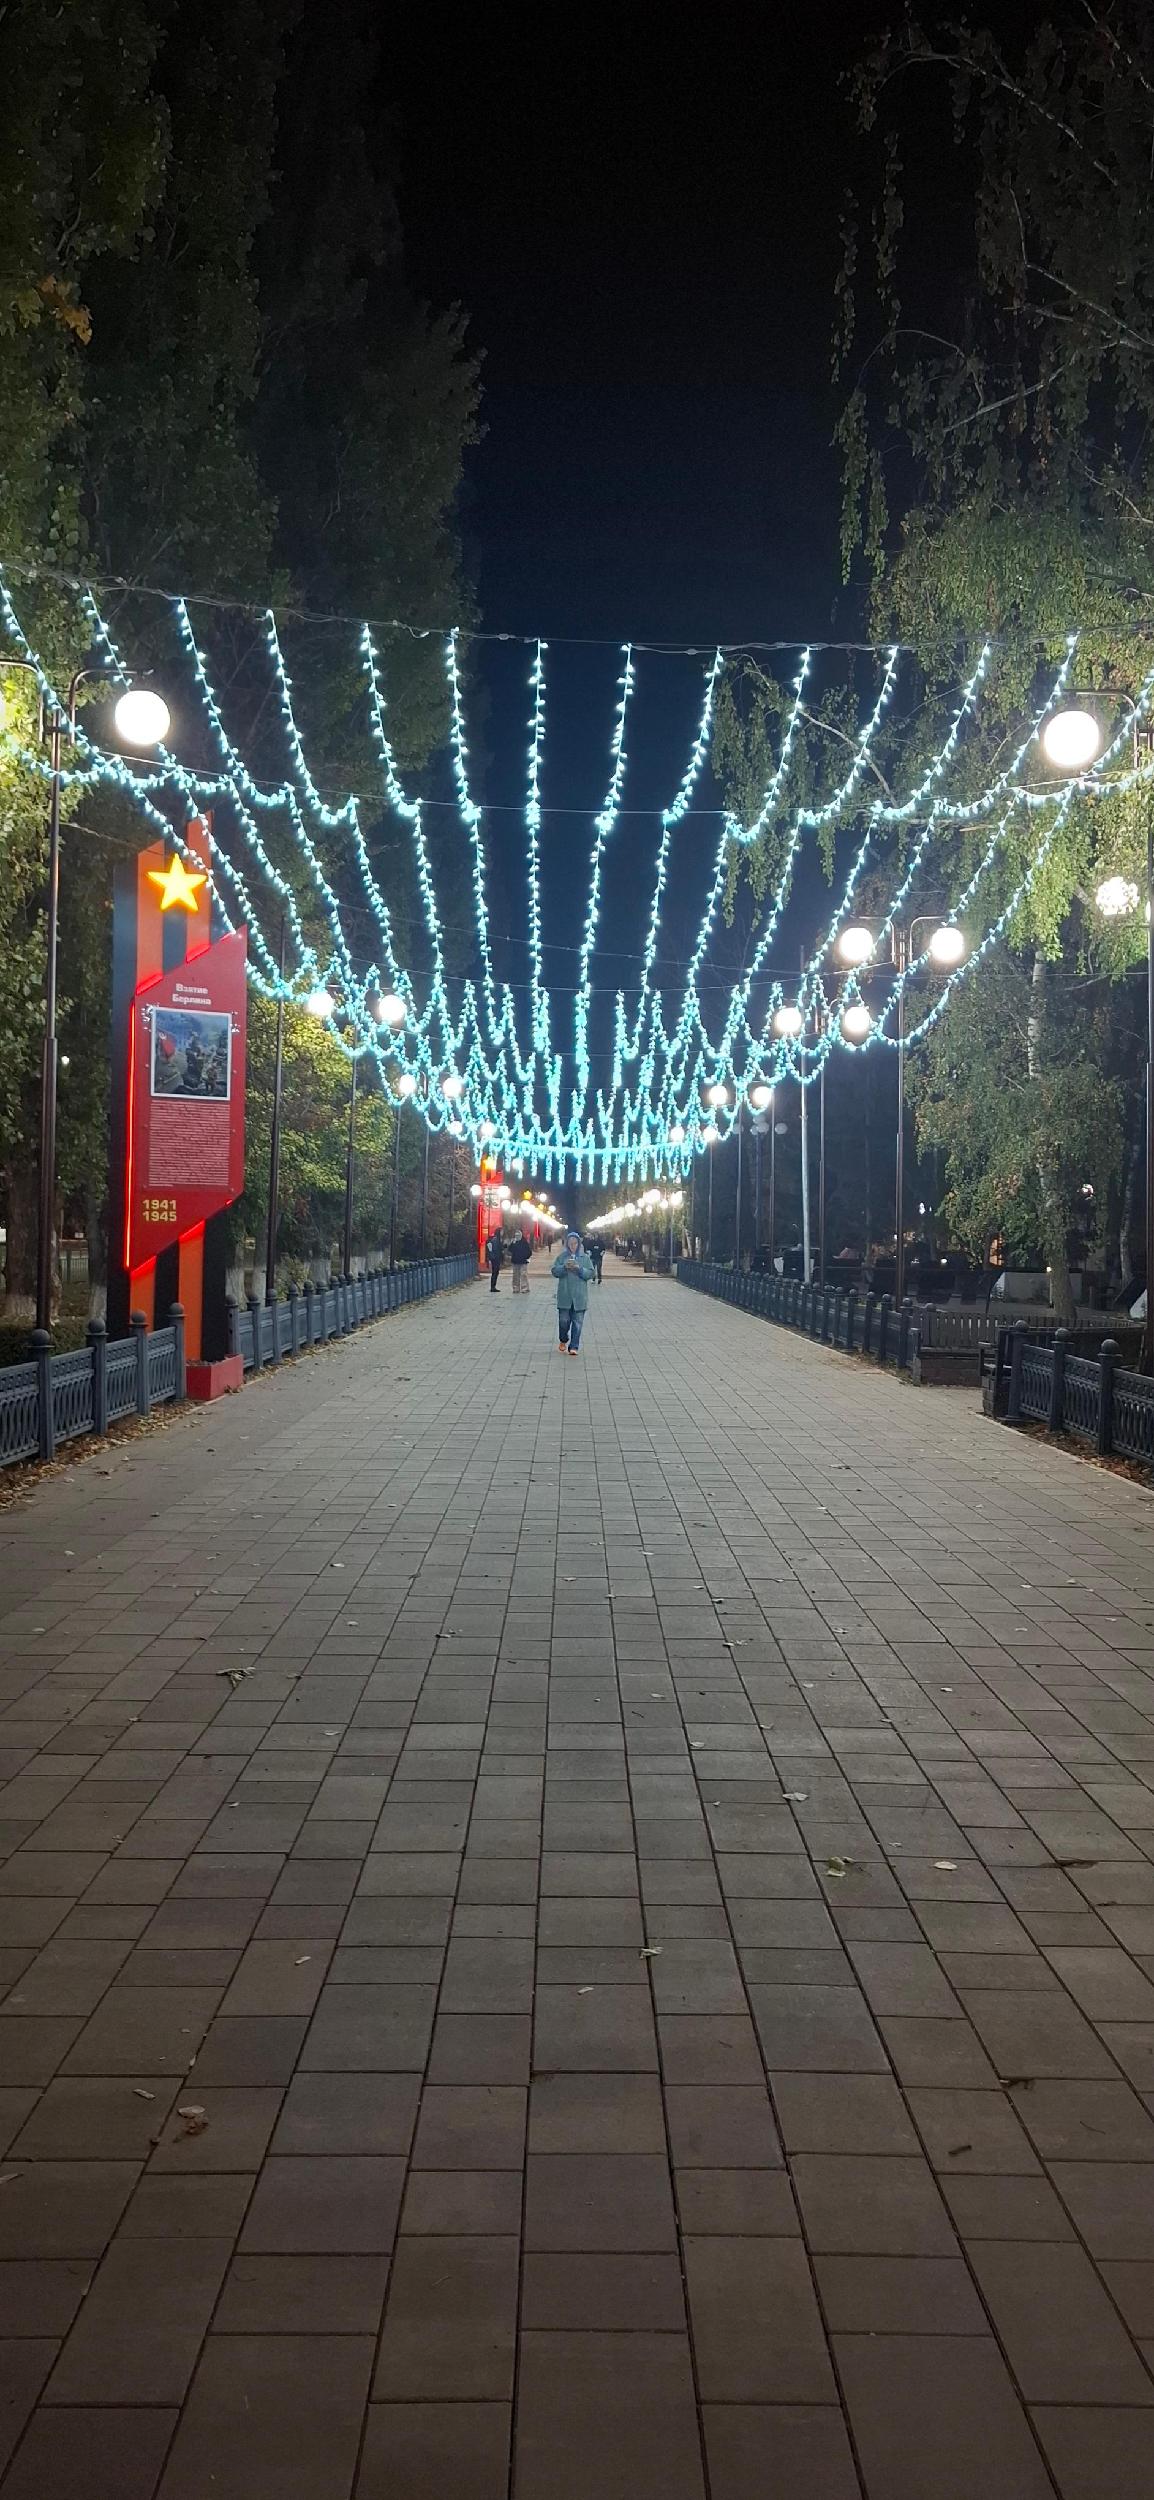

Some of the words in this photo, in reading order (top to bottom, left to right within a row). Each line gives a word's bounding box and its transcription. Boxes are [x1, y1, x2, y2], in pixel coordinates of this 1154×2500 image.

[175, 983, 209, 994] Взятие
[172, 993, 212, 1005] Берлина
[142, 1199, 177, 1210] 1941
[142, 1211, 177, 1222] 1945
